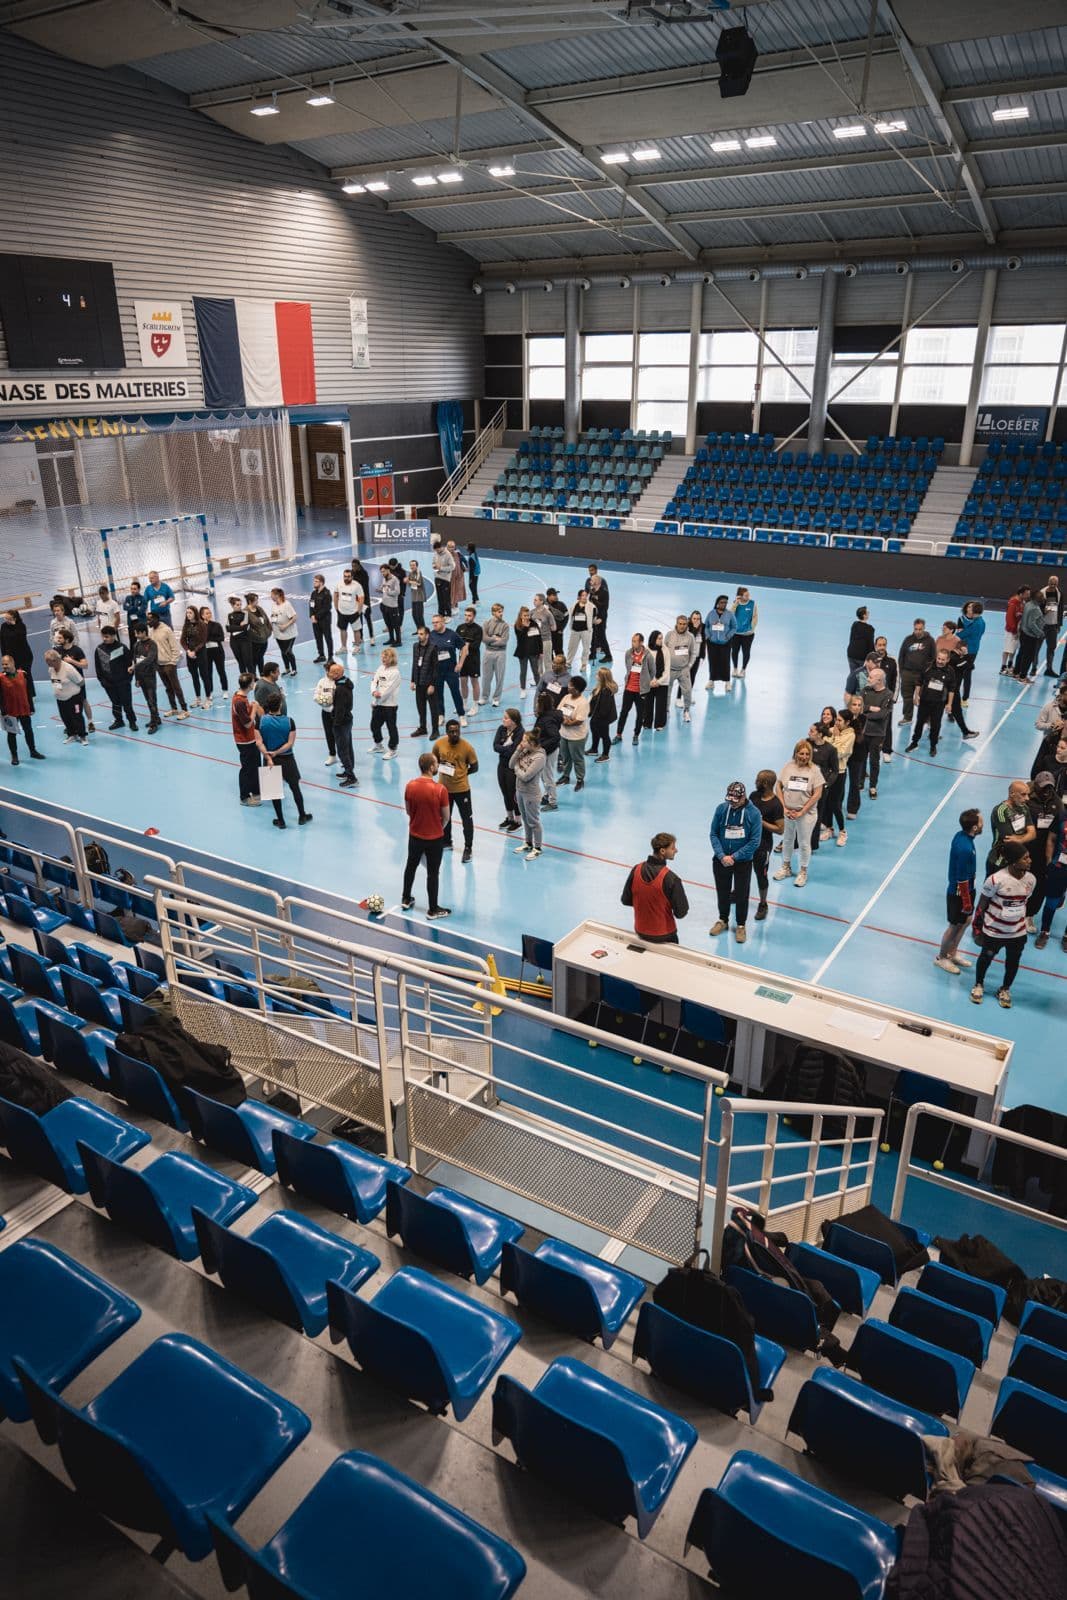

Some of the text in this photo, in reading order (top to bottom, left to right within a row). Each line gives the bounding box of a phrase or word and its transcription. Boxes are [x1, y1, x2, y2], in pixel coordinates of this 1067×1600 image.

[62, 294, 71, 307] 4
[55, 383, 91, 400] DES
[96, 381, 187, 399] MALTERIES
[990, 419, 1039, 431] LOEBER
[387, 528, 428, 538] LOEBER
